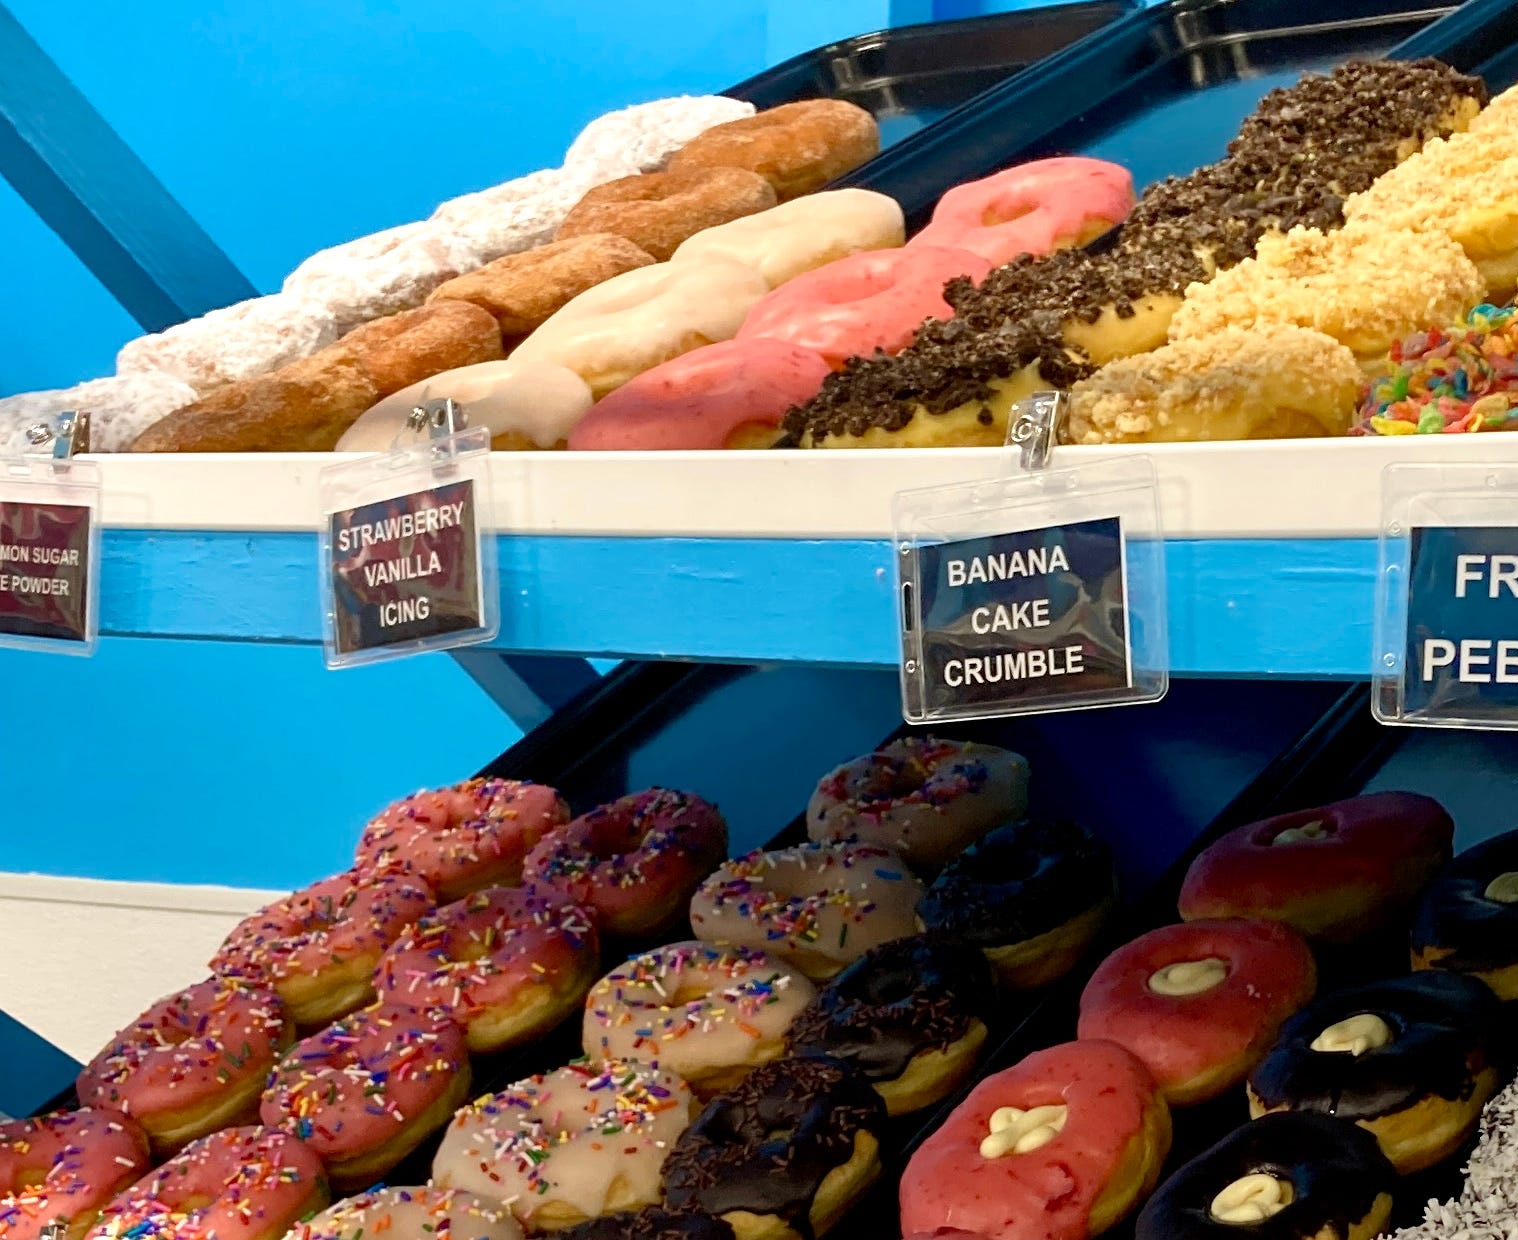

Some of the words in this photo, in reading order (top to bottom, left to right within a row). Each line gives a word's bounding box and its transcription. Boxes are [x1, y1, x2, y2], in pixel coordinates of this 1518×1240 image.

[338, 501, 464, 551] STRAWBERRY
[32, 547, 79, 566] SUGAR
[363, 551, 442, 587] VANILLA
[947, 545, 1070, 587] BANANA
[11, 575, 70, 596] POWDER
[379, 596, 430, 627] ICING
[971, 599, 1051, 635] CAKE
[943, 645, 1085, 688] CRUMBLE
